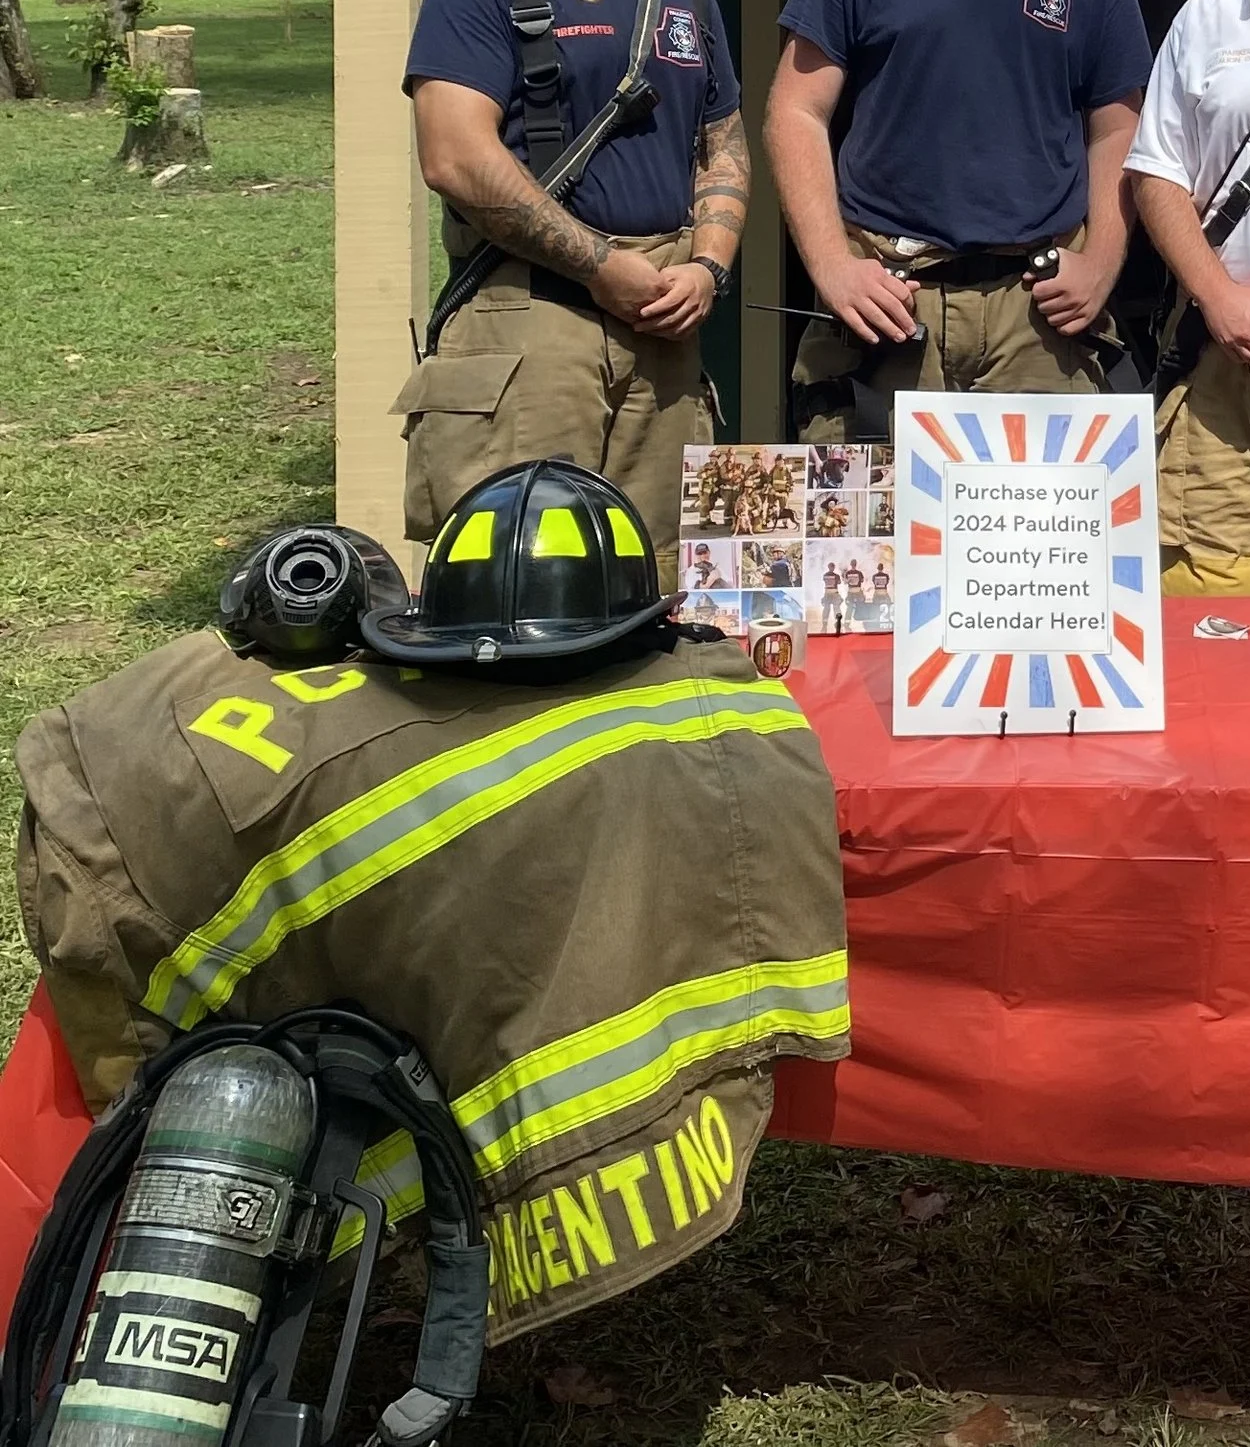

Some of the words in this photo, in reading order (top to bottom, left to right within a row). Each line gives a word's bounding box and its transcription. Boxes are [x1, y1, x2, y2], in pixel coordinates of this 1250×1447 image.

[955, 483, 1047, 501] Purchase
[1053, 488, 1100, 505] your
[953, 515, 1007, 532] 2024
[1014, 515, 1101, 537] Paulding
[966, 546, 1042, 568] County
[1049, 547, 1089, 564] Fire
[966, 579, 1090, 601] Department
[948, 611, 1044, 629] Calendar
[1050, 612, 1106, 629] Here!
[114, 1321, 230, 1376] MSA
